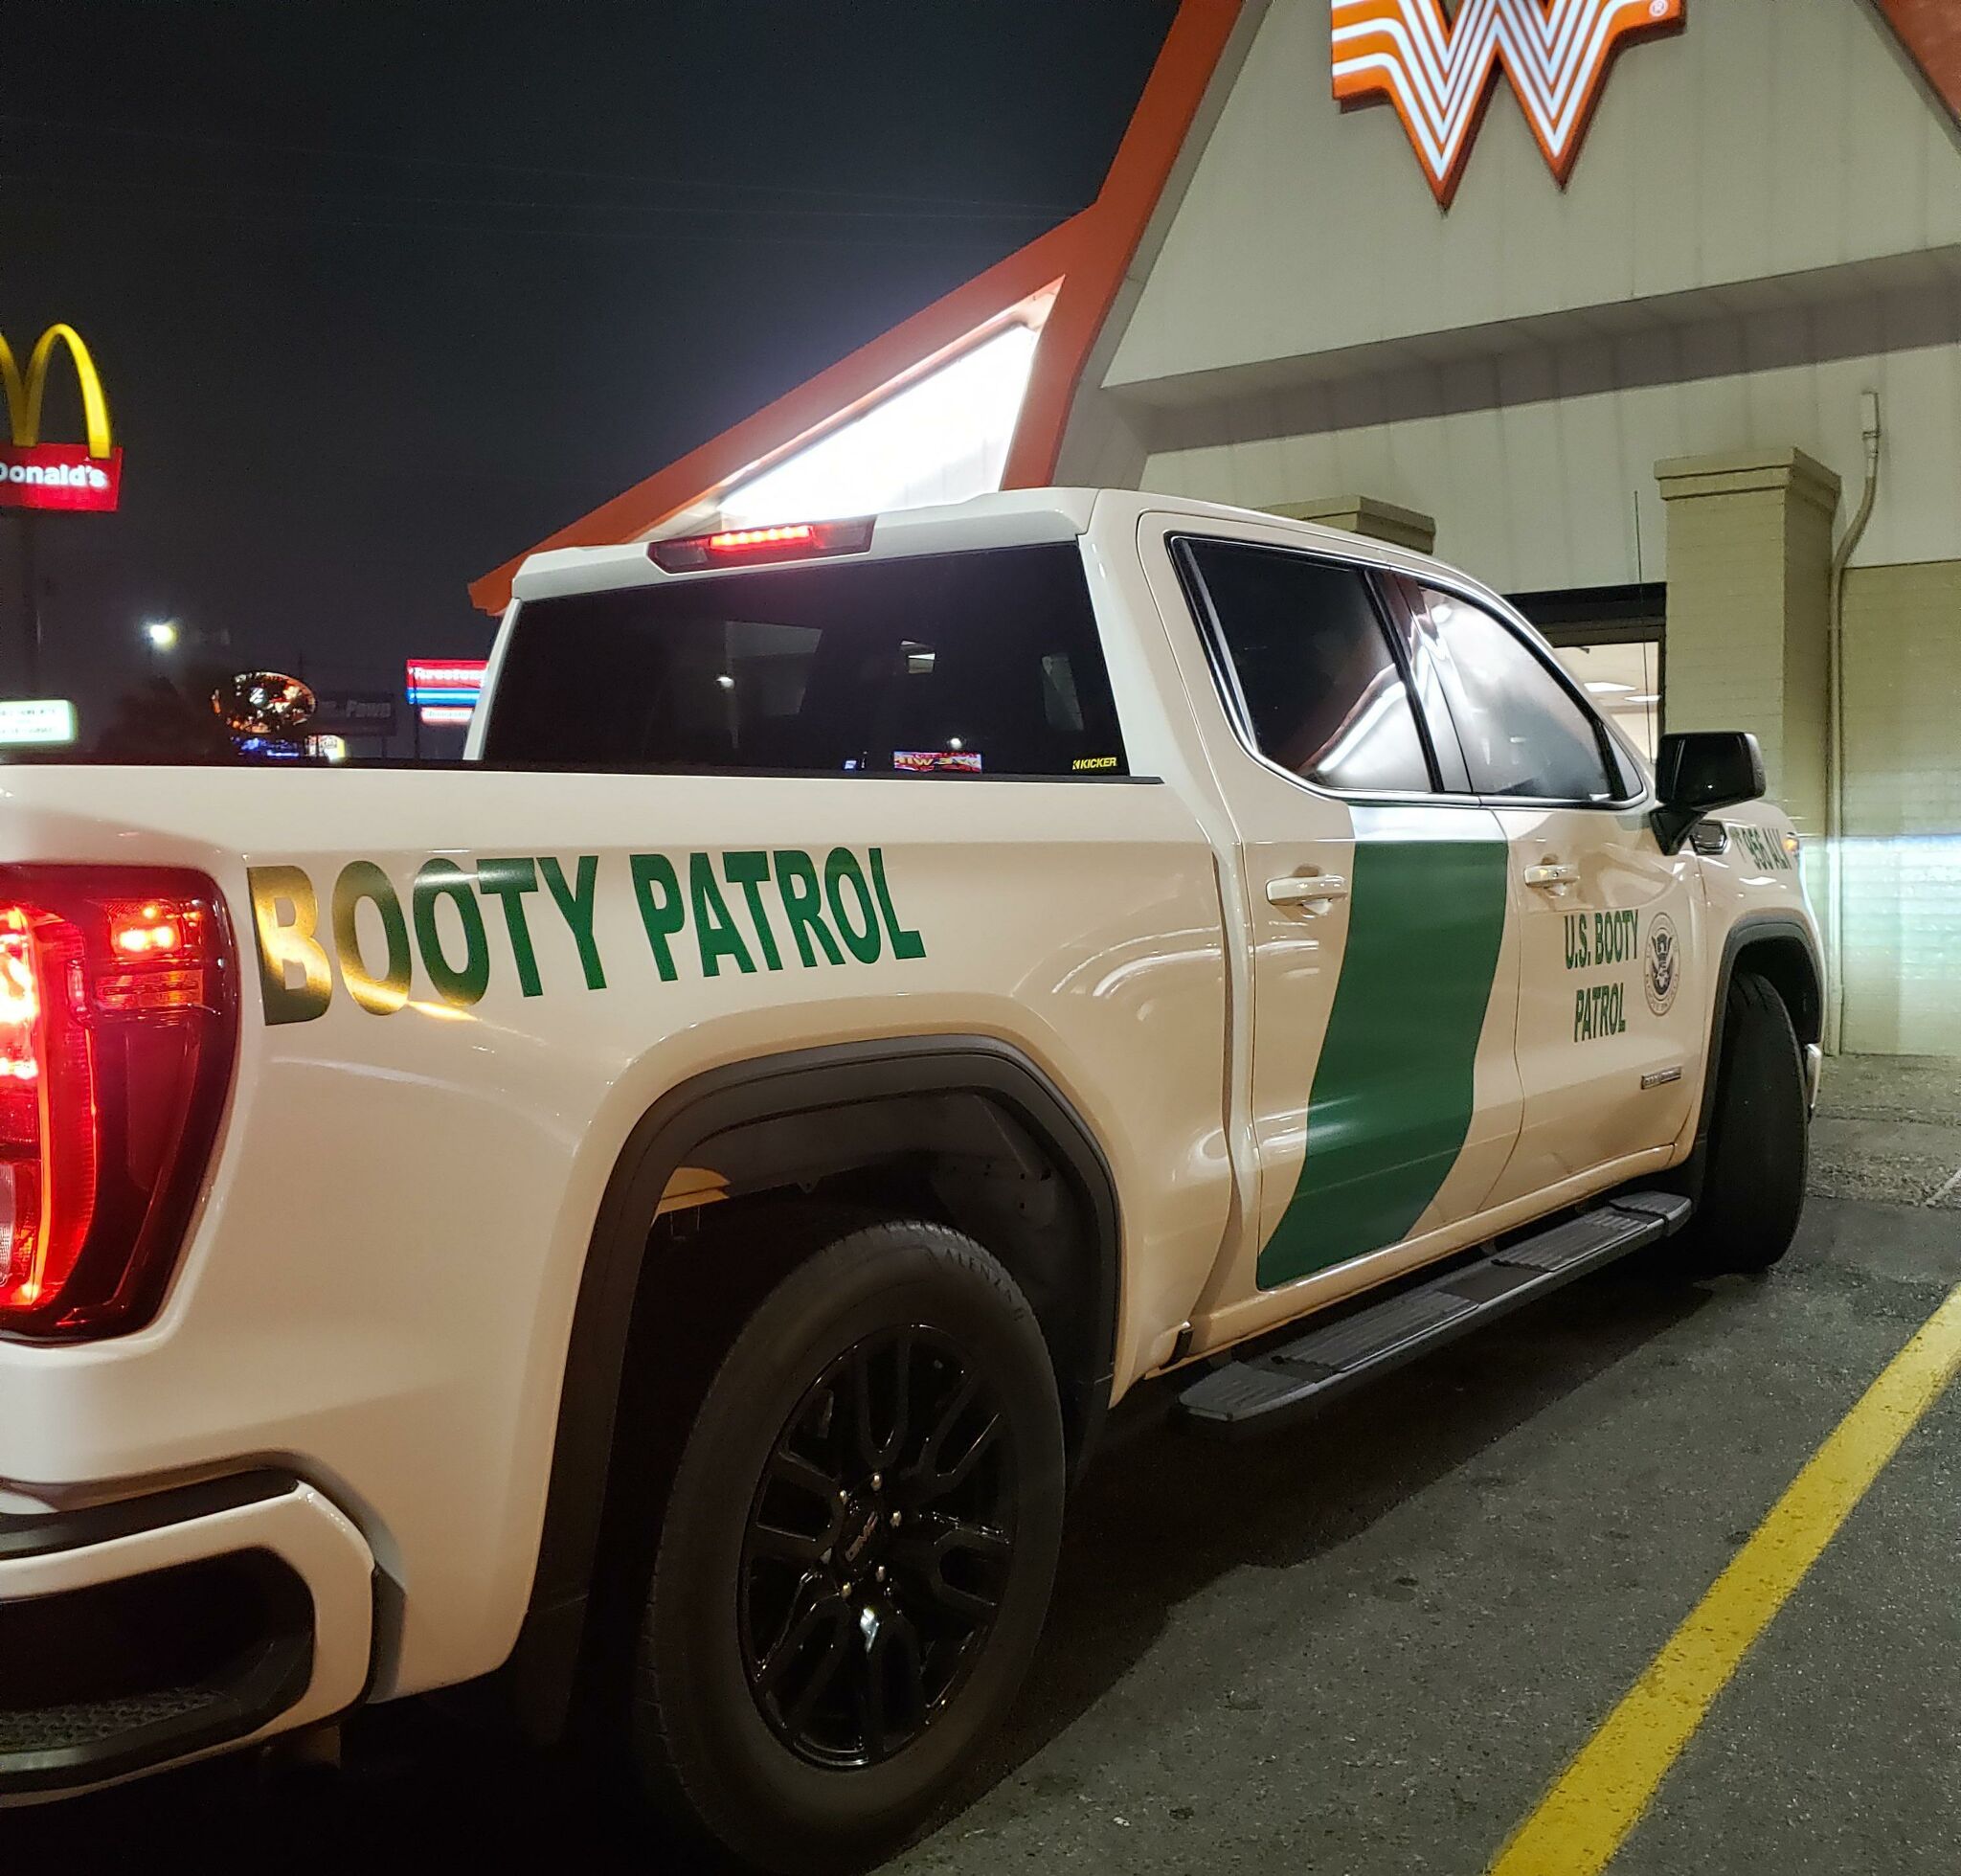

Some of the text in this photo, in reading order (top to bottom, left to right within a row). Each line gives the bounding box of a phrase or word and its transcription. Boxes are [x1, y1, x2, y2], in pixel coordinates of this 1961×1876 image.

[1080, 757, 1117, 769] KICKER
[247, 847, 926, 1027] BOOTY PATROL
[1564, 914, 1591, 970] U.S.
[1594, 910, 1638, 965] BOOTY
[1573, 982, 1626, 1042] PATROL
